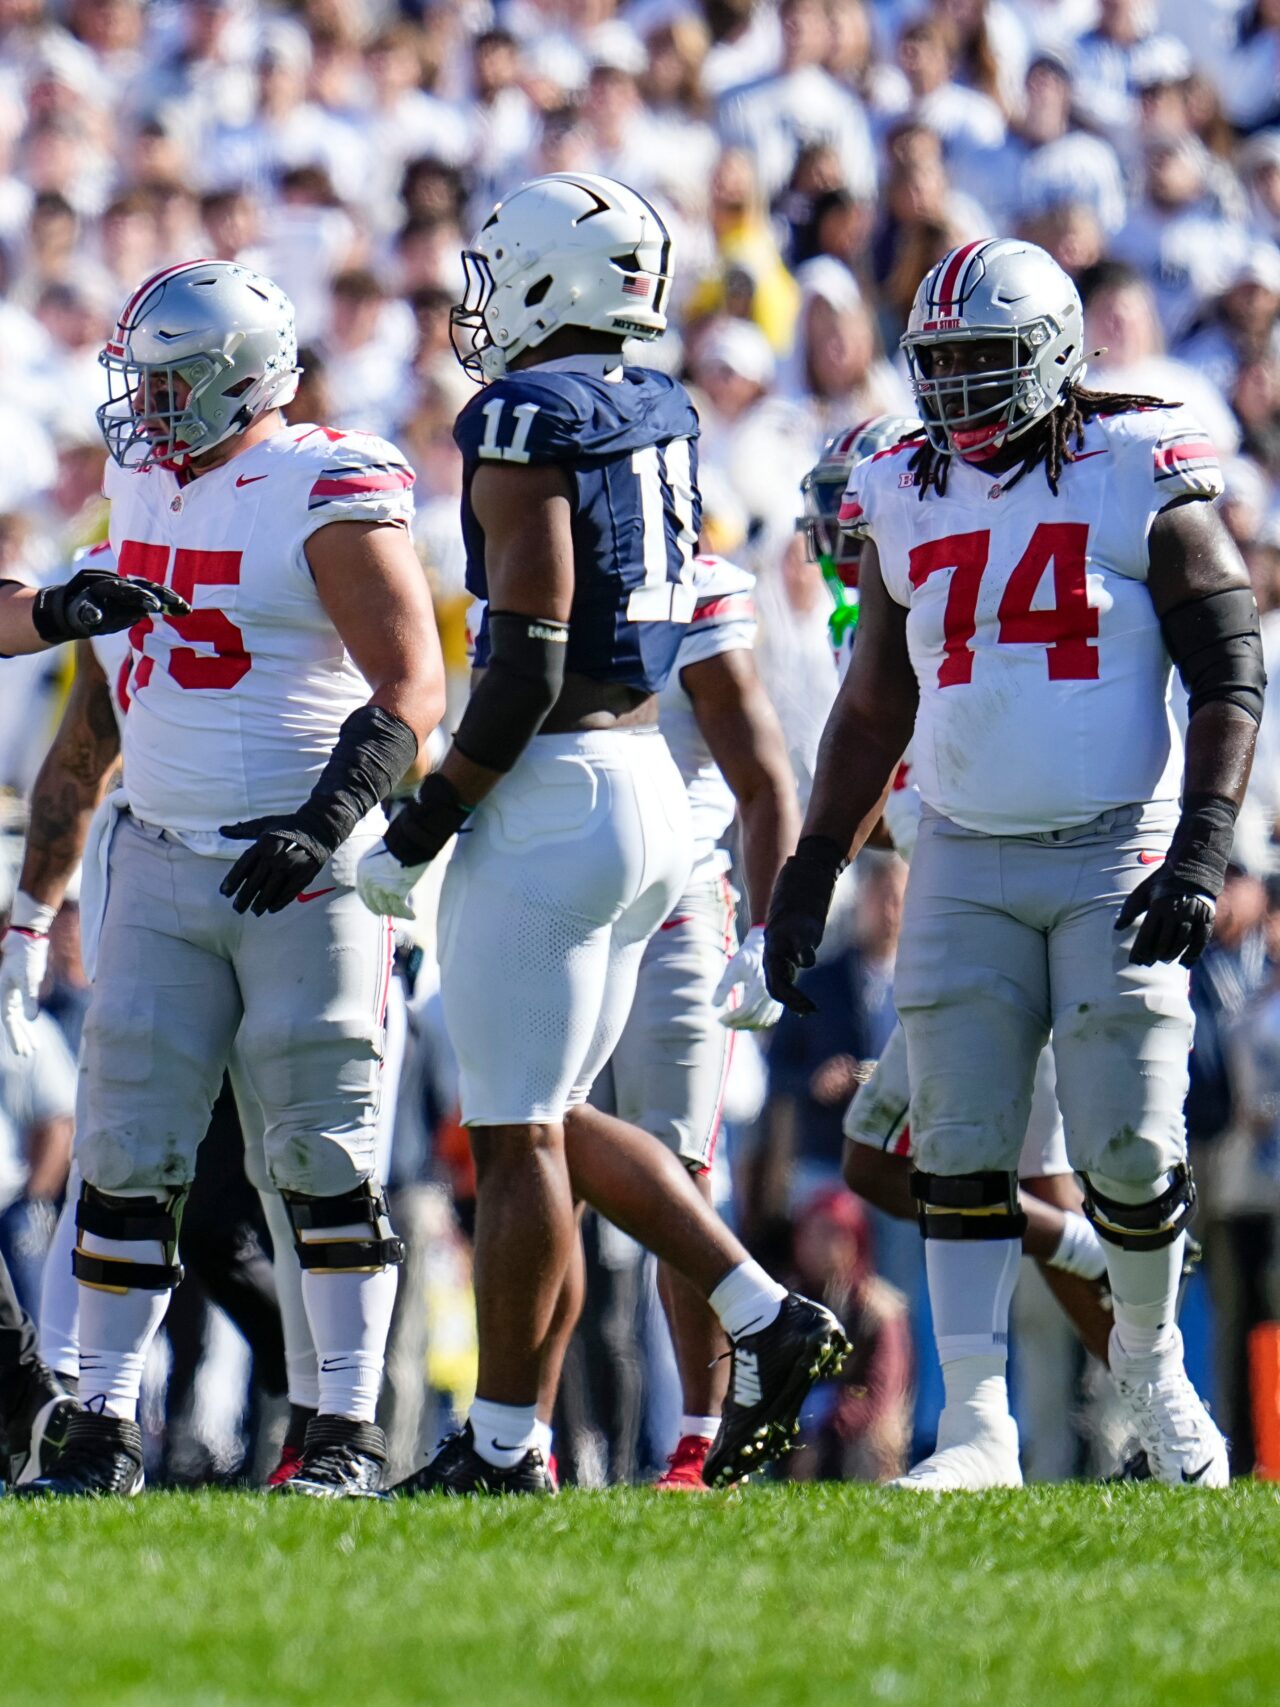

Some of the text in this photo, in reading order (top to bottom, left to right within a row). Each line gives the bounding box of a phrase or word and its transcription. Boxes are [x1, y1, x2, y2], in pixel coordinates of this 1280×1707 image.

[478, 398, 540, 464] 11
[627, 434, 698, 623] 11
[117, 540, 252, 692] 75
[909, 522, 1099, 689] 74
[734, 1347, 763, 1408] NIKE
